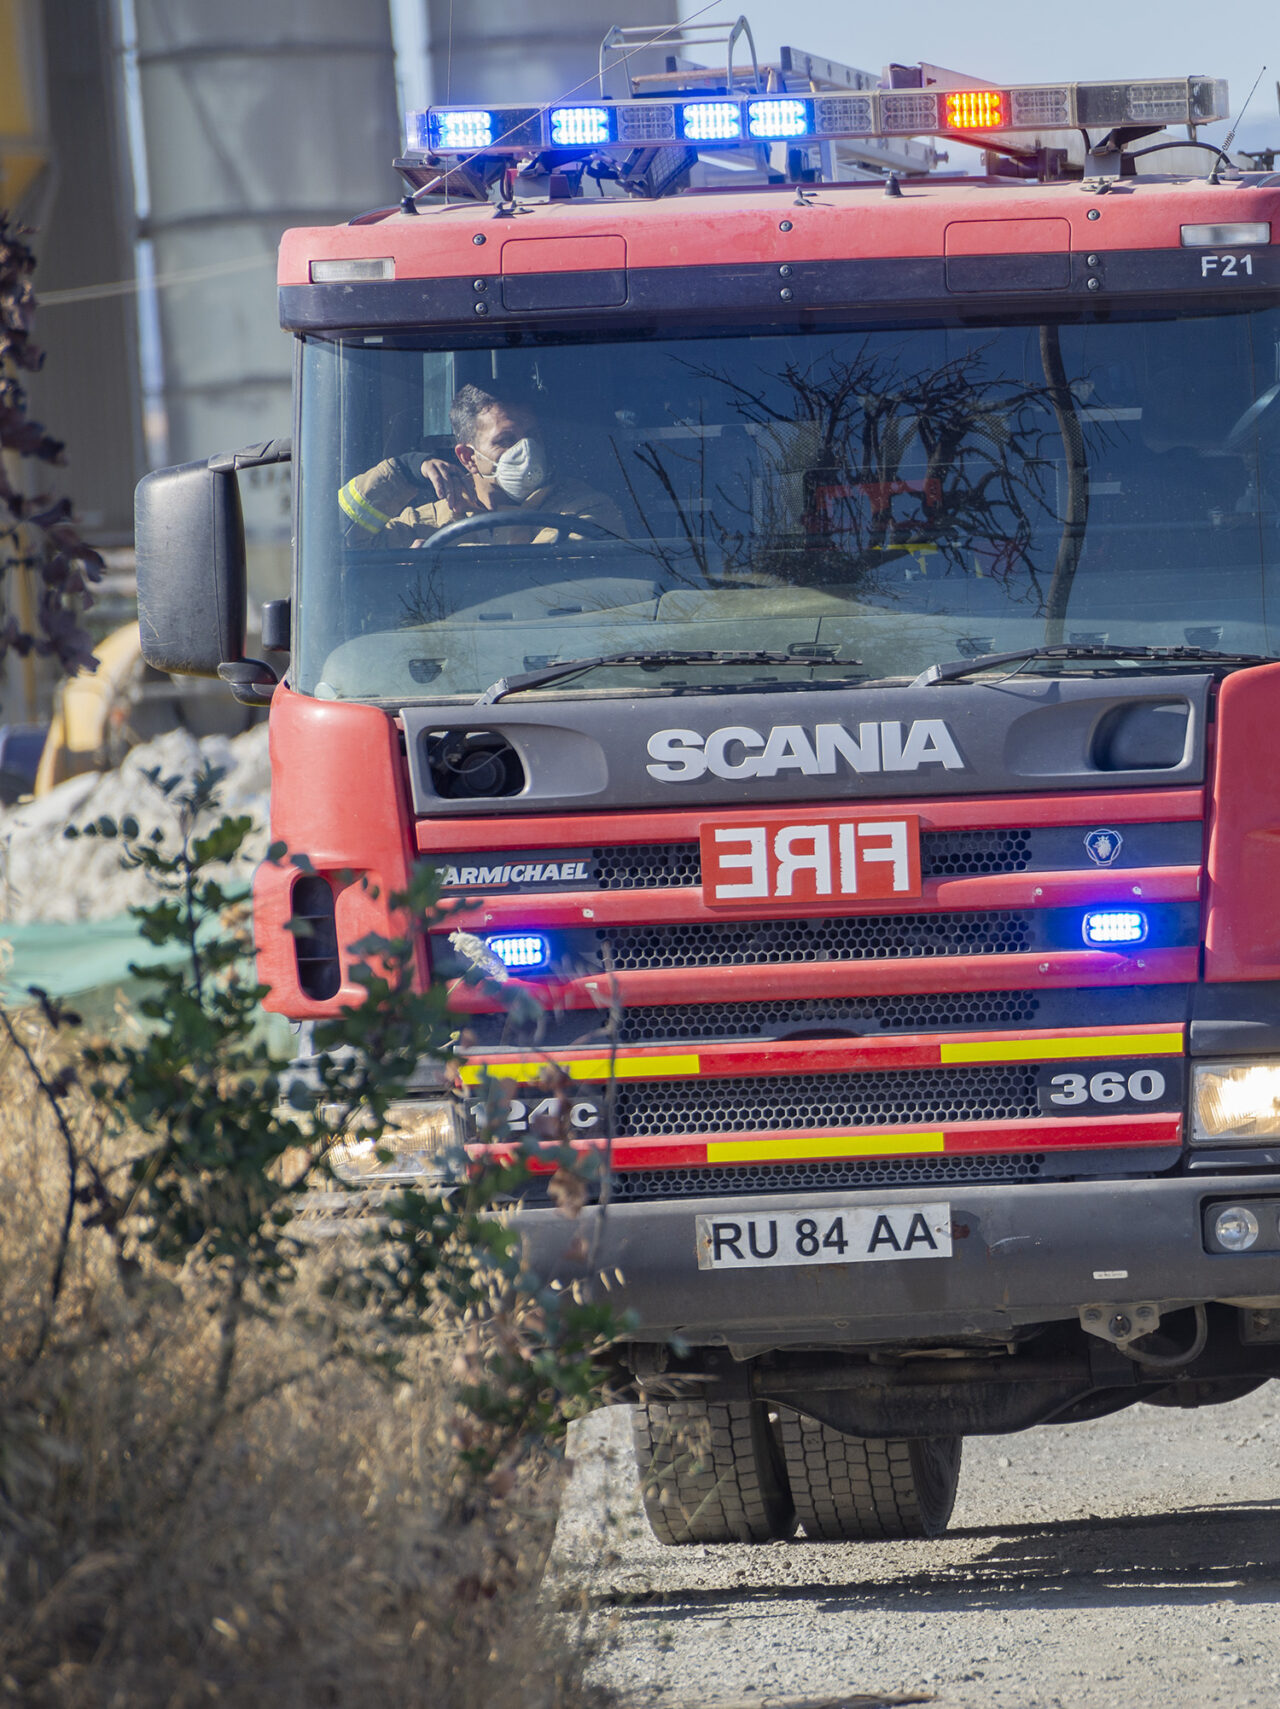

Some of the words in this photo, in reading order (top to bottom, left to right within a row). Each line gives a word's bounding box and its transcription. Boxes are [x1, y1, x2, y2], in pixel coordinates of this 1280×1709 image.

[1201, 254, 1253, 277] F21
[646, 719, 965, 782] SCANIA
[1050, 1069, 1166, 1105] 360
[712, 1220, 778, 1261] RU
[795, 1217, 848, 1257] 84
[867, 1213, 938, 1253] AA
